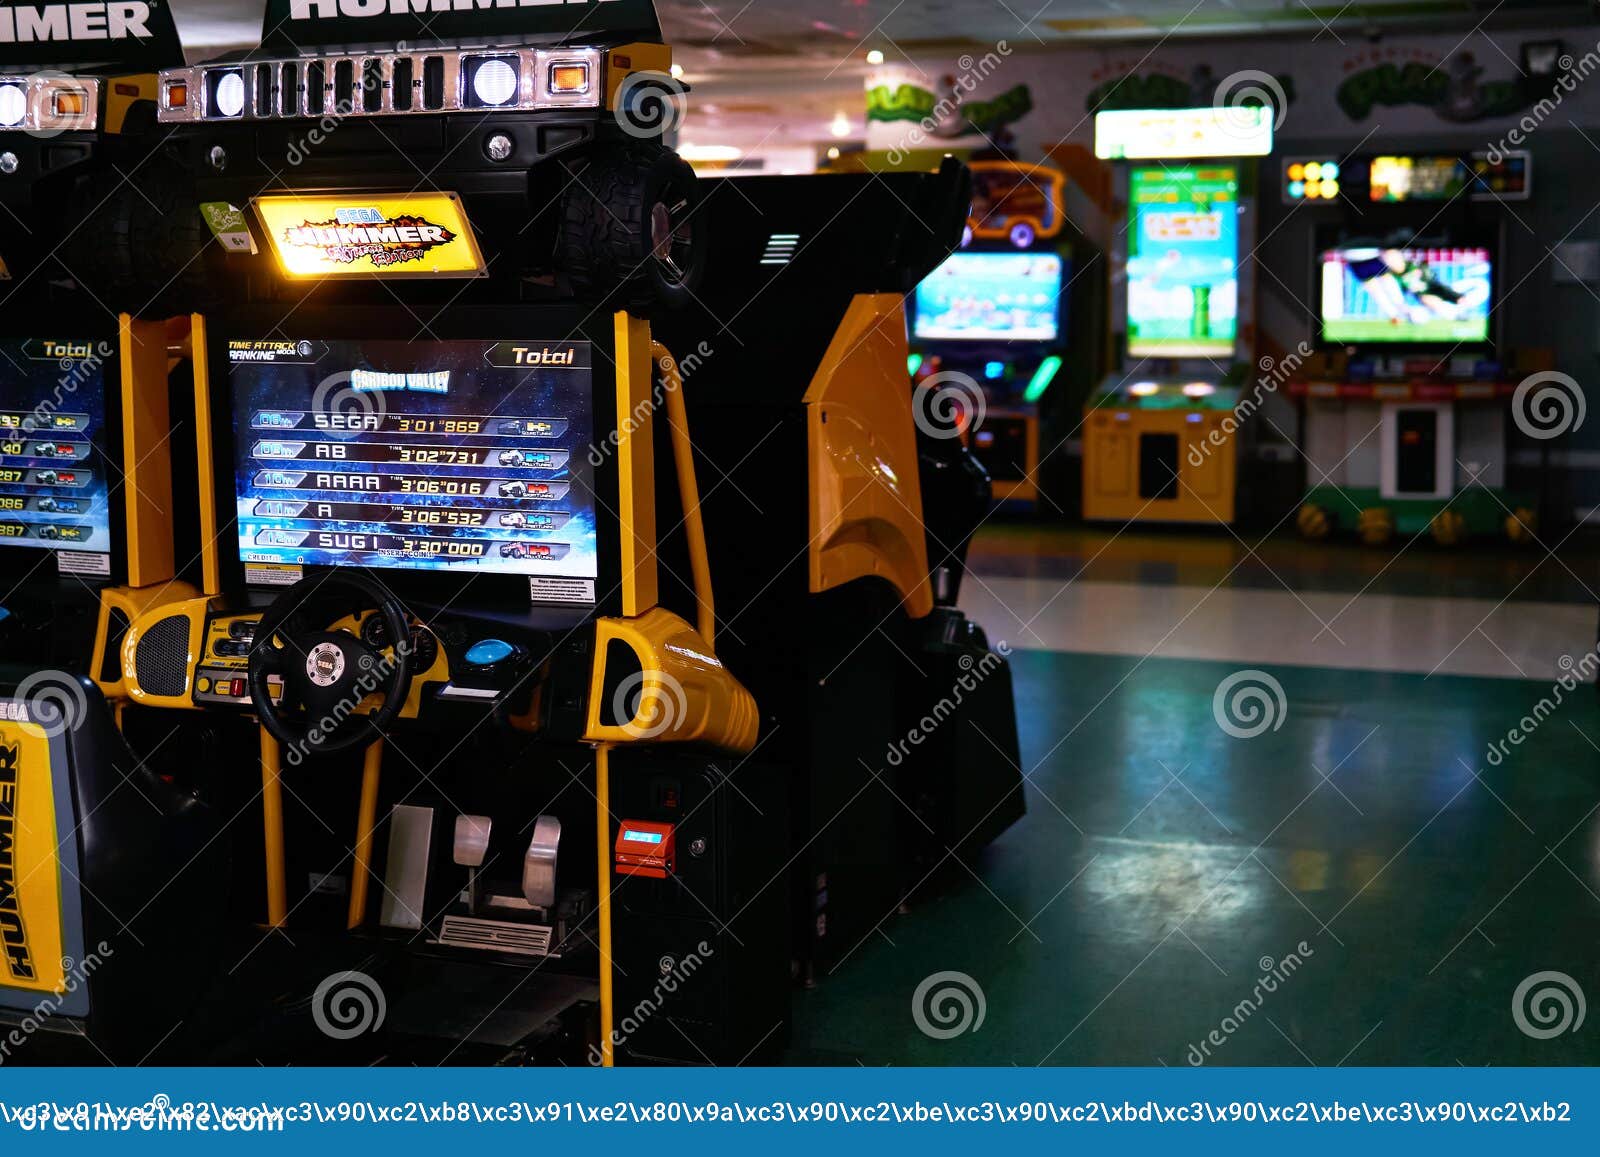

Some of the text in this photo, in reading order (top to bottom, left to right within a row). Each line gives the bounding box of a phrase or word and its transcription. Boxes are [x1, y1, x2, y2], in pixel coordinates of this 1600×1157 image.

[336, 208, 384, 223] SEGA
[287, 226, 447, 244] HUMMER
[43, 341, 92, 358] Total
[229, 341, 296, 351] TIME ATTACK
[229, 350, 276, 361] RANKING
[512, 347, 575, 365] Total
[352, 369, 451, 394] CARIBOU VALLEY
[0, 415, 21, 427] 93
[315, 415, 378, 430] SEGA
[315, 444, 346, 459] AB
[316, 474, 380, 490] AAAA
[318, 504, 332, 518] A
[319, 533, 378, 550] SUGI
[378, 549, 405, 558] INSERT
[0, 702, 30, 722] EGA
